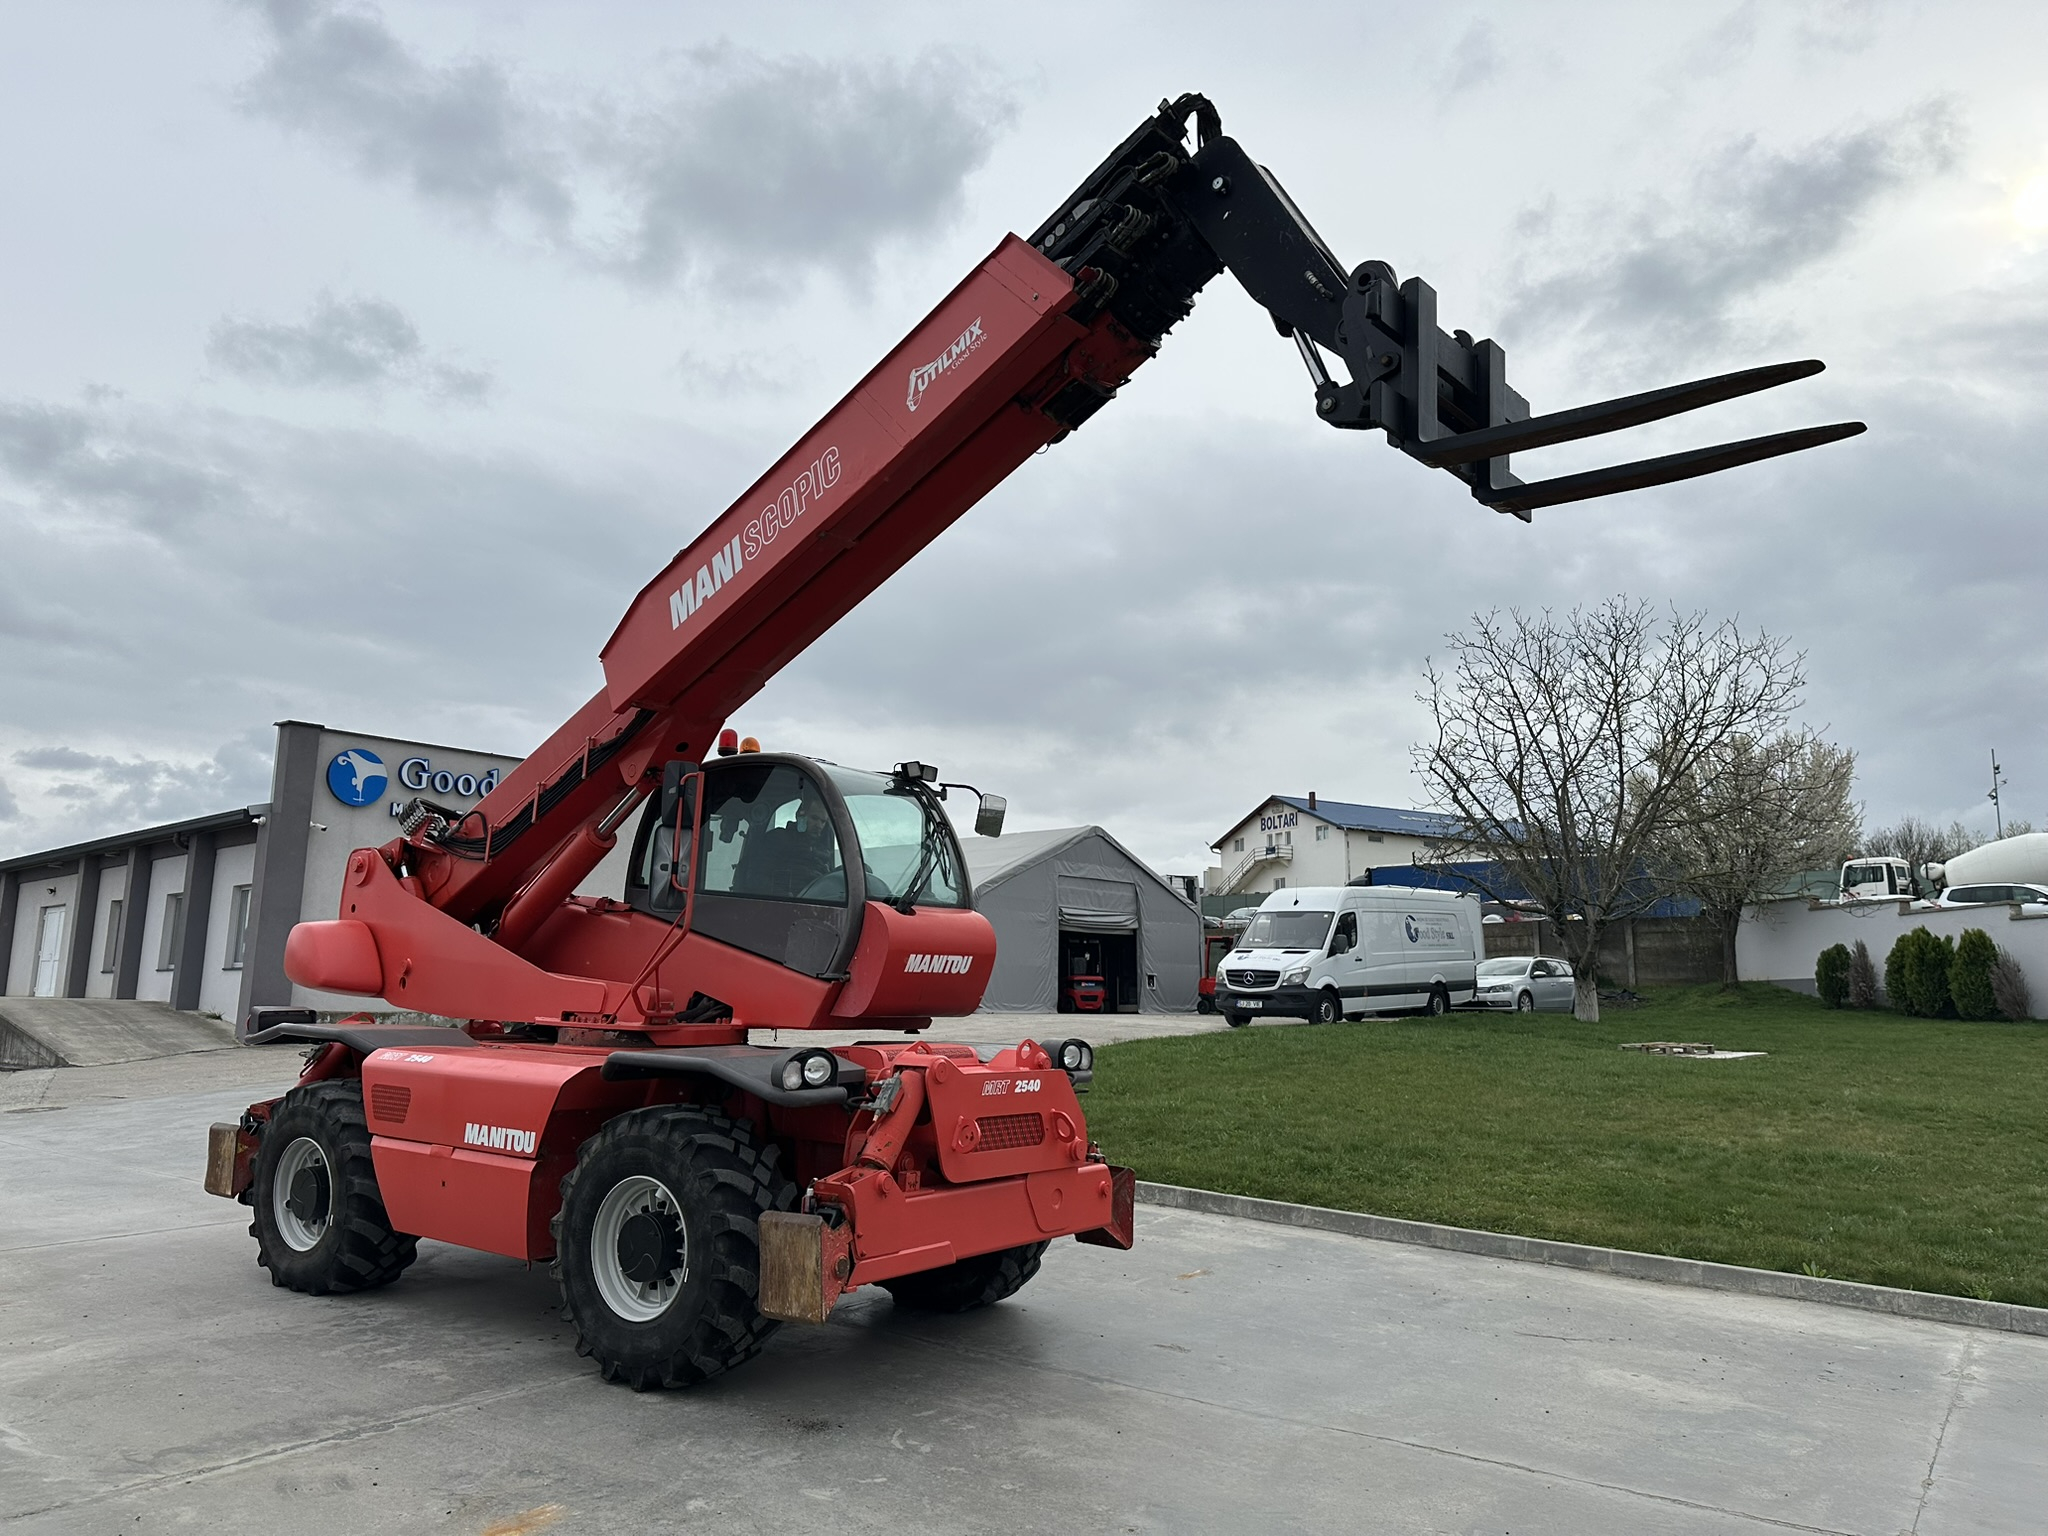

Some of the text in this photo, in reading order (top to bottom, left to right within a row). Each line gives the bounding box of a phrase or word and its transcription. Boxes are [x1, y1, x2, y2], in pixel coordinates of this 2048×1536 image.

[917, 318, 983, 392] UTILMIX
[951, 333, 988, 370] Good Style
[398, 757, 500, 799] Good
[1260, 812, 1298, 832] BOLTARI
[904, 954, 974, 975] MANITOU
[981, 1079, 1041, 1096] MRT 2540
[463, 1122, 537, 1154] MANITOU
